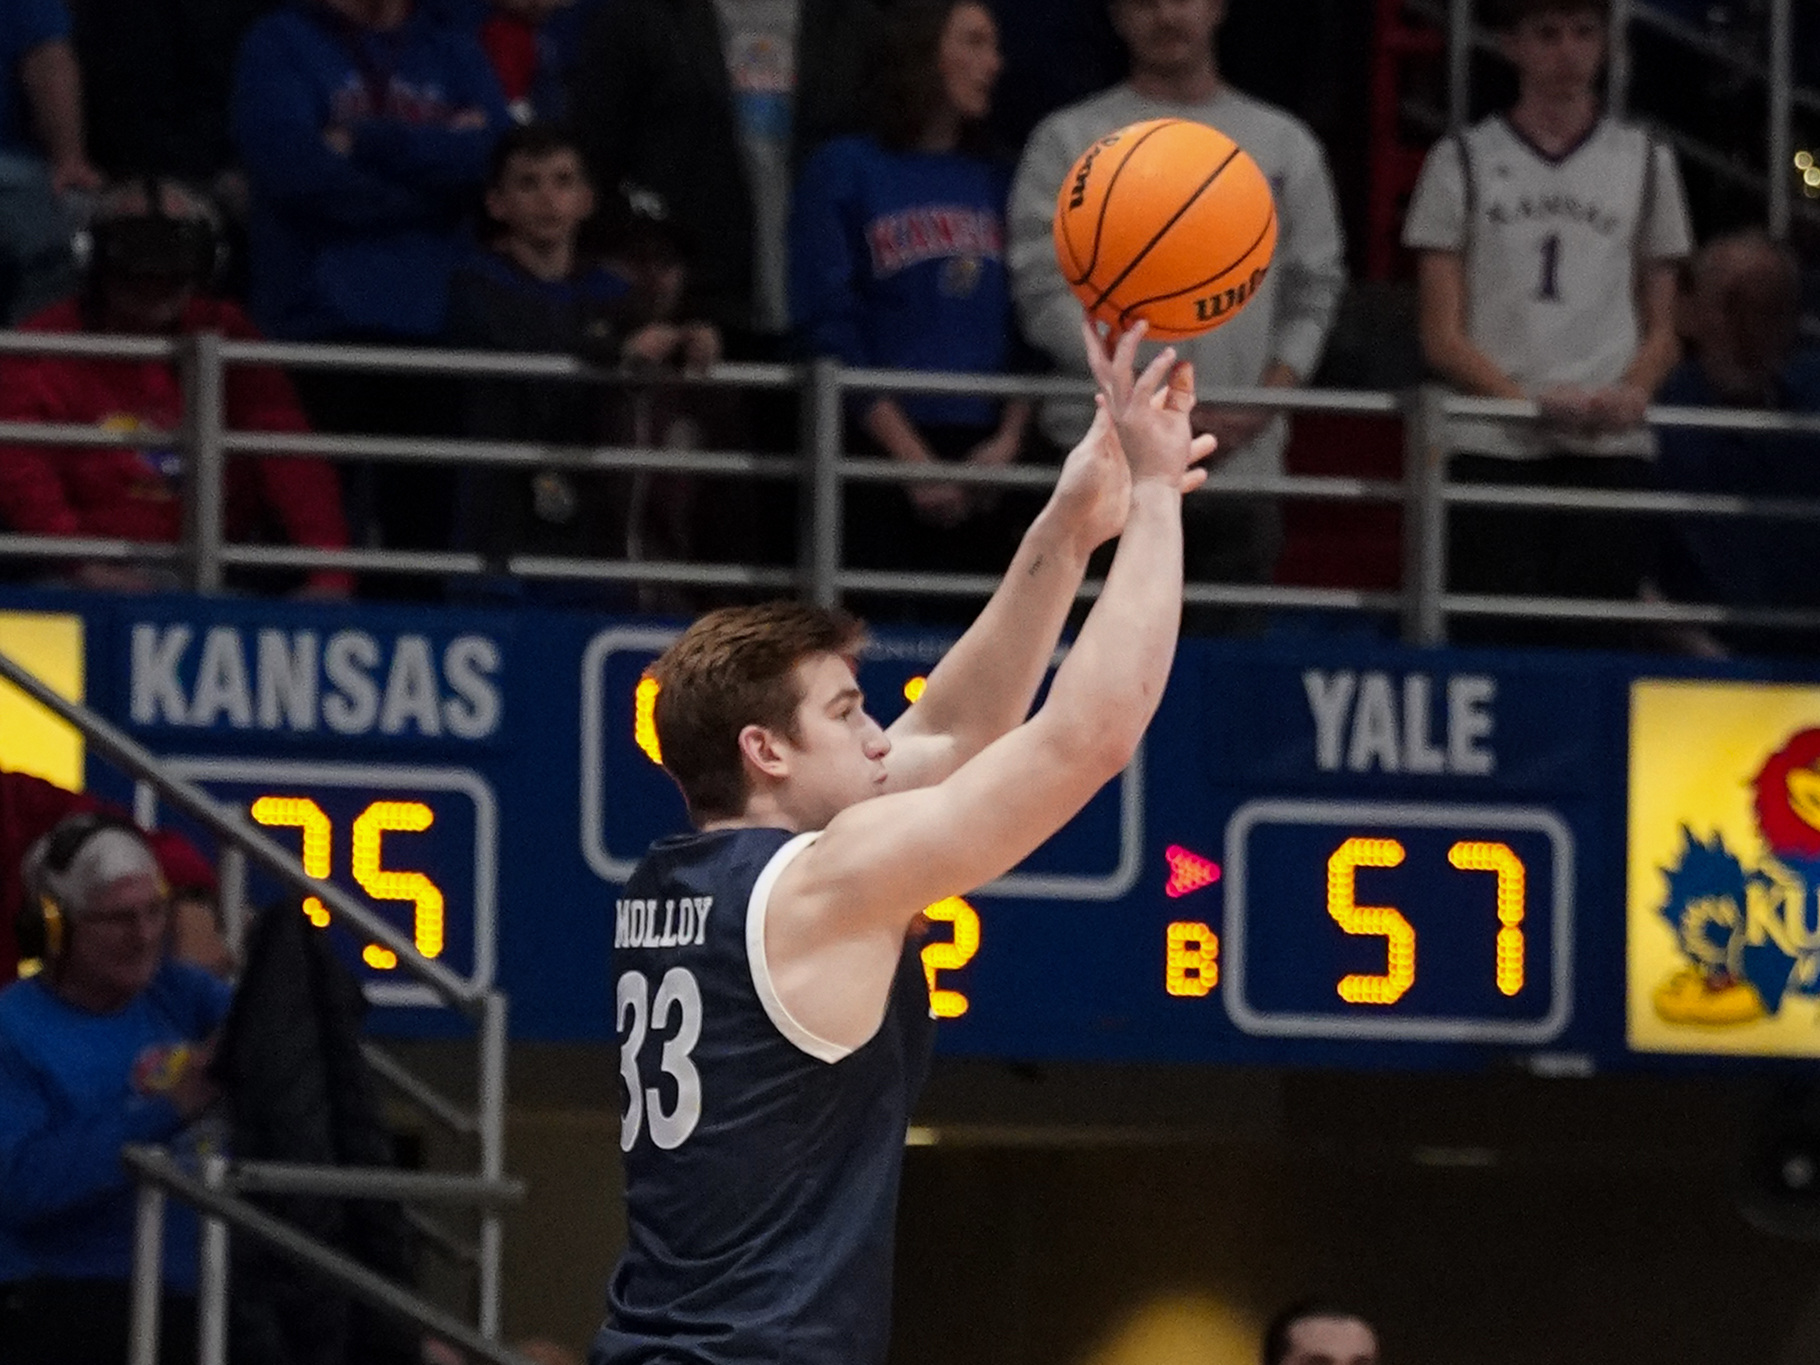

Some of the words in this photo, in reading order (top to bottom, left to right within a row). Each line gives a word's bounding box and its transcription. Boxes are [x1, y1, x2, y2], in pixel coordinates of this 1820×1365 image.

[1536, 231, 1562, 302] 1
[130, 622, 500, 739] KANSAS
[1303, 668, 1496, 776] YALE
[251, 796, 444, 970] 75
[614, 896, 714, 949] MOLLOY
[1327, 837, 1526, 1005] 57
[1166, 922, 1219, 997] B
[616, 966, 704, 1153] 33
